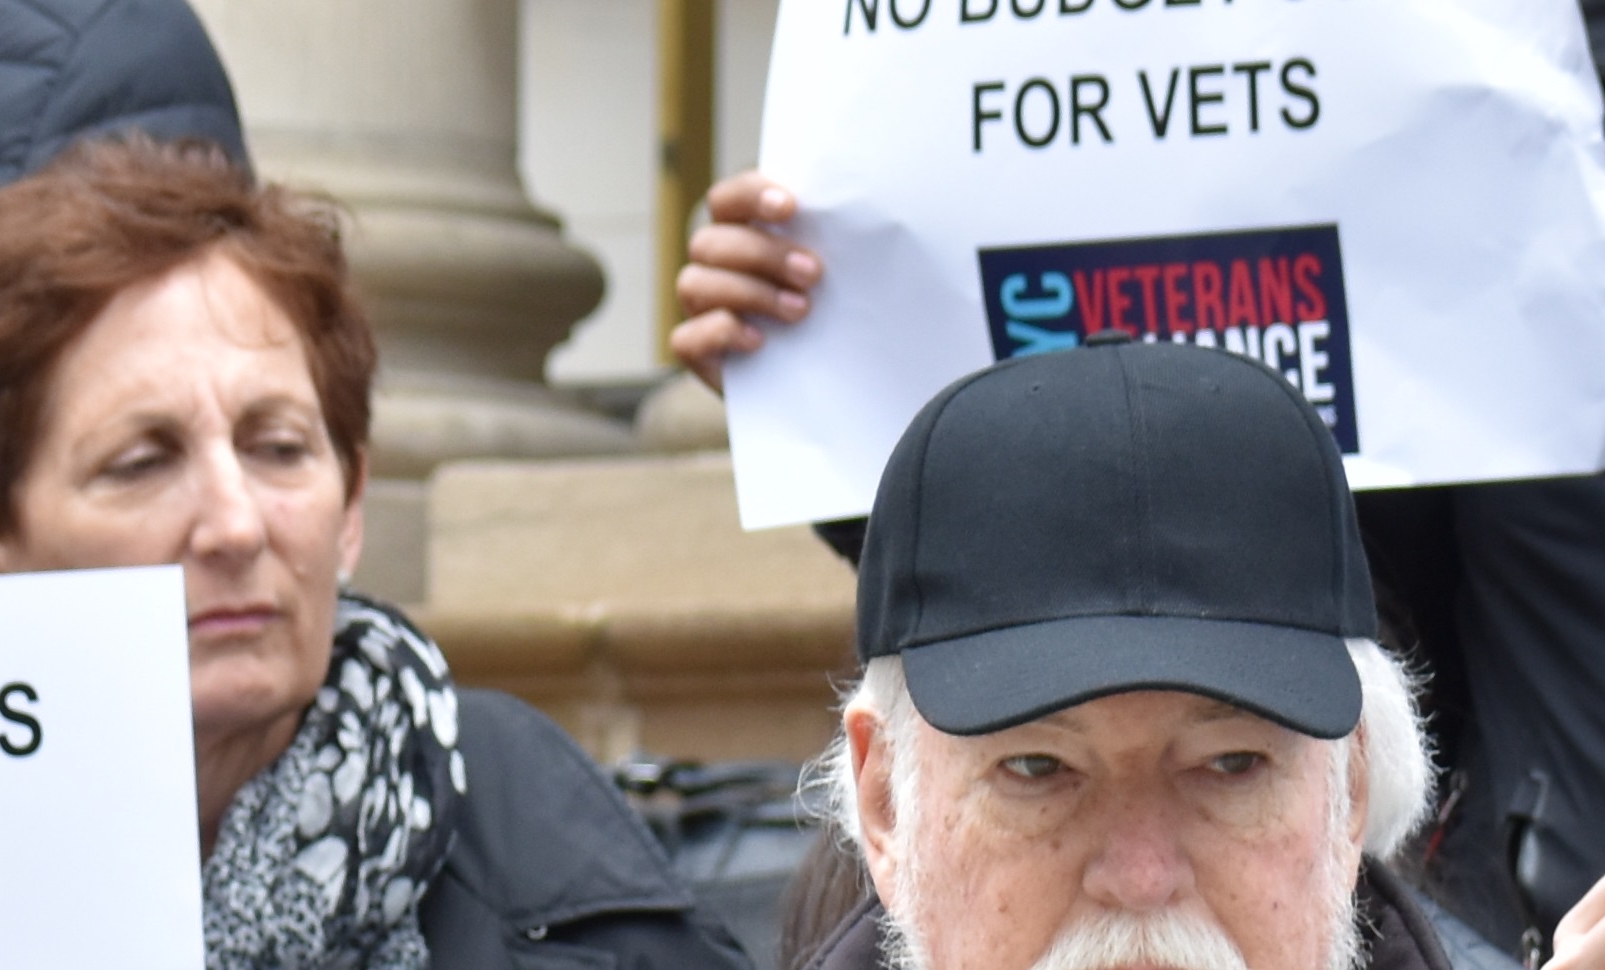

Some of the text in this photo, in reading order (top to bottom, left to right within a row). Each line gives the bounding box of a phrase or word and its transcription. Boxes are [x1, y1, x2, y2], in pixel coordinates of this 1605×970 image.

[972, 56, 1321, 153] FOR VETS
[1000, 270, 1079, 358] YC
[1073, 252, 1328, 339] VETERANS
